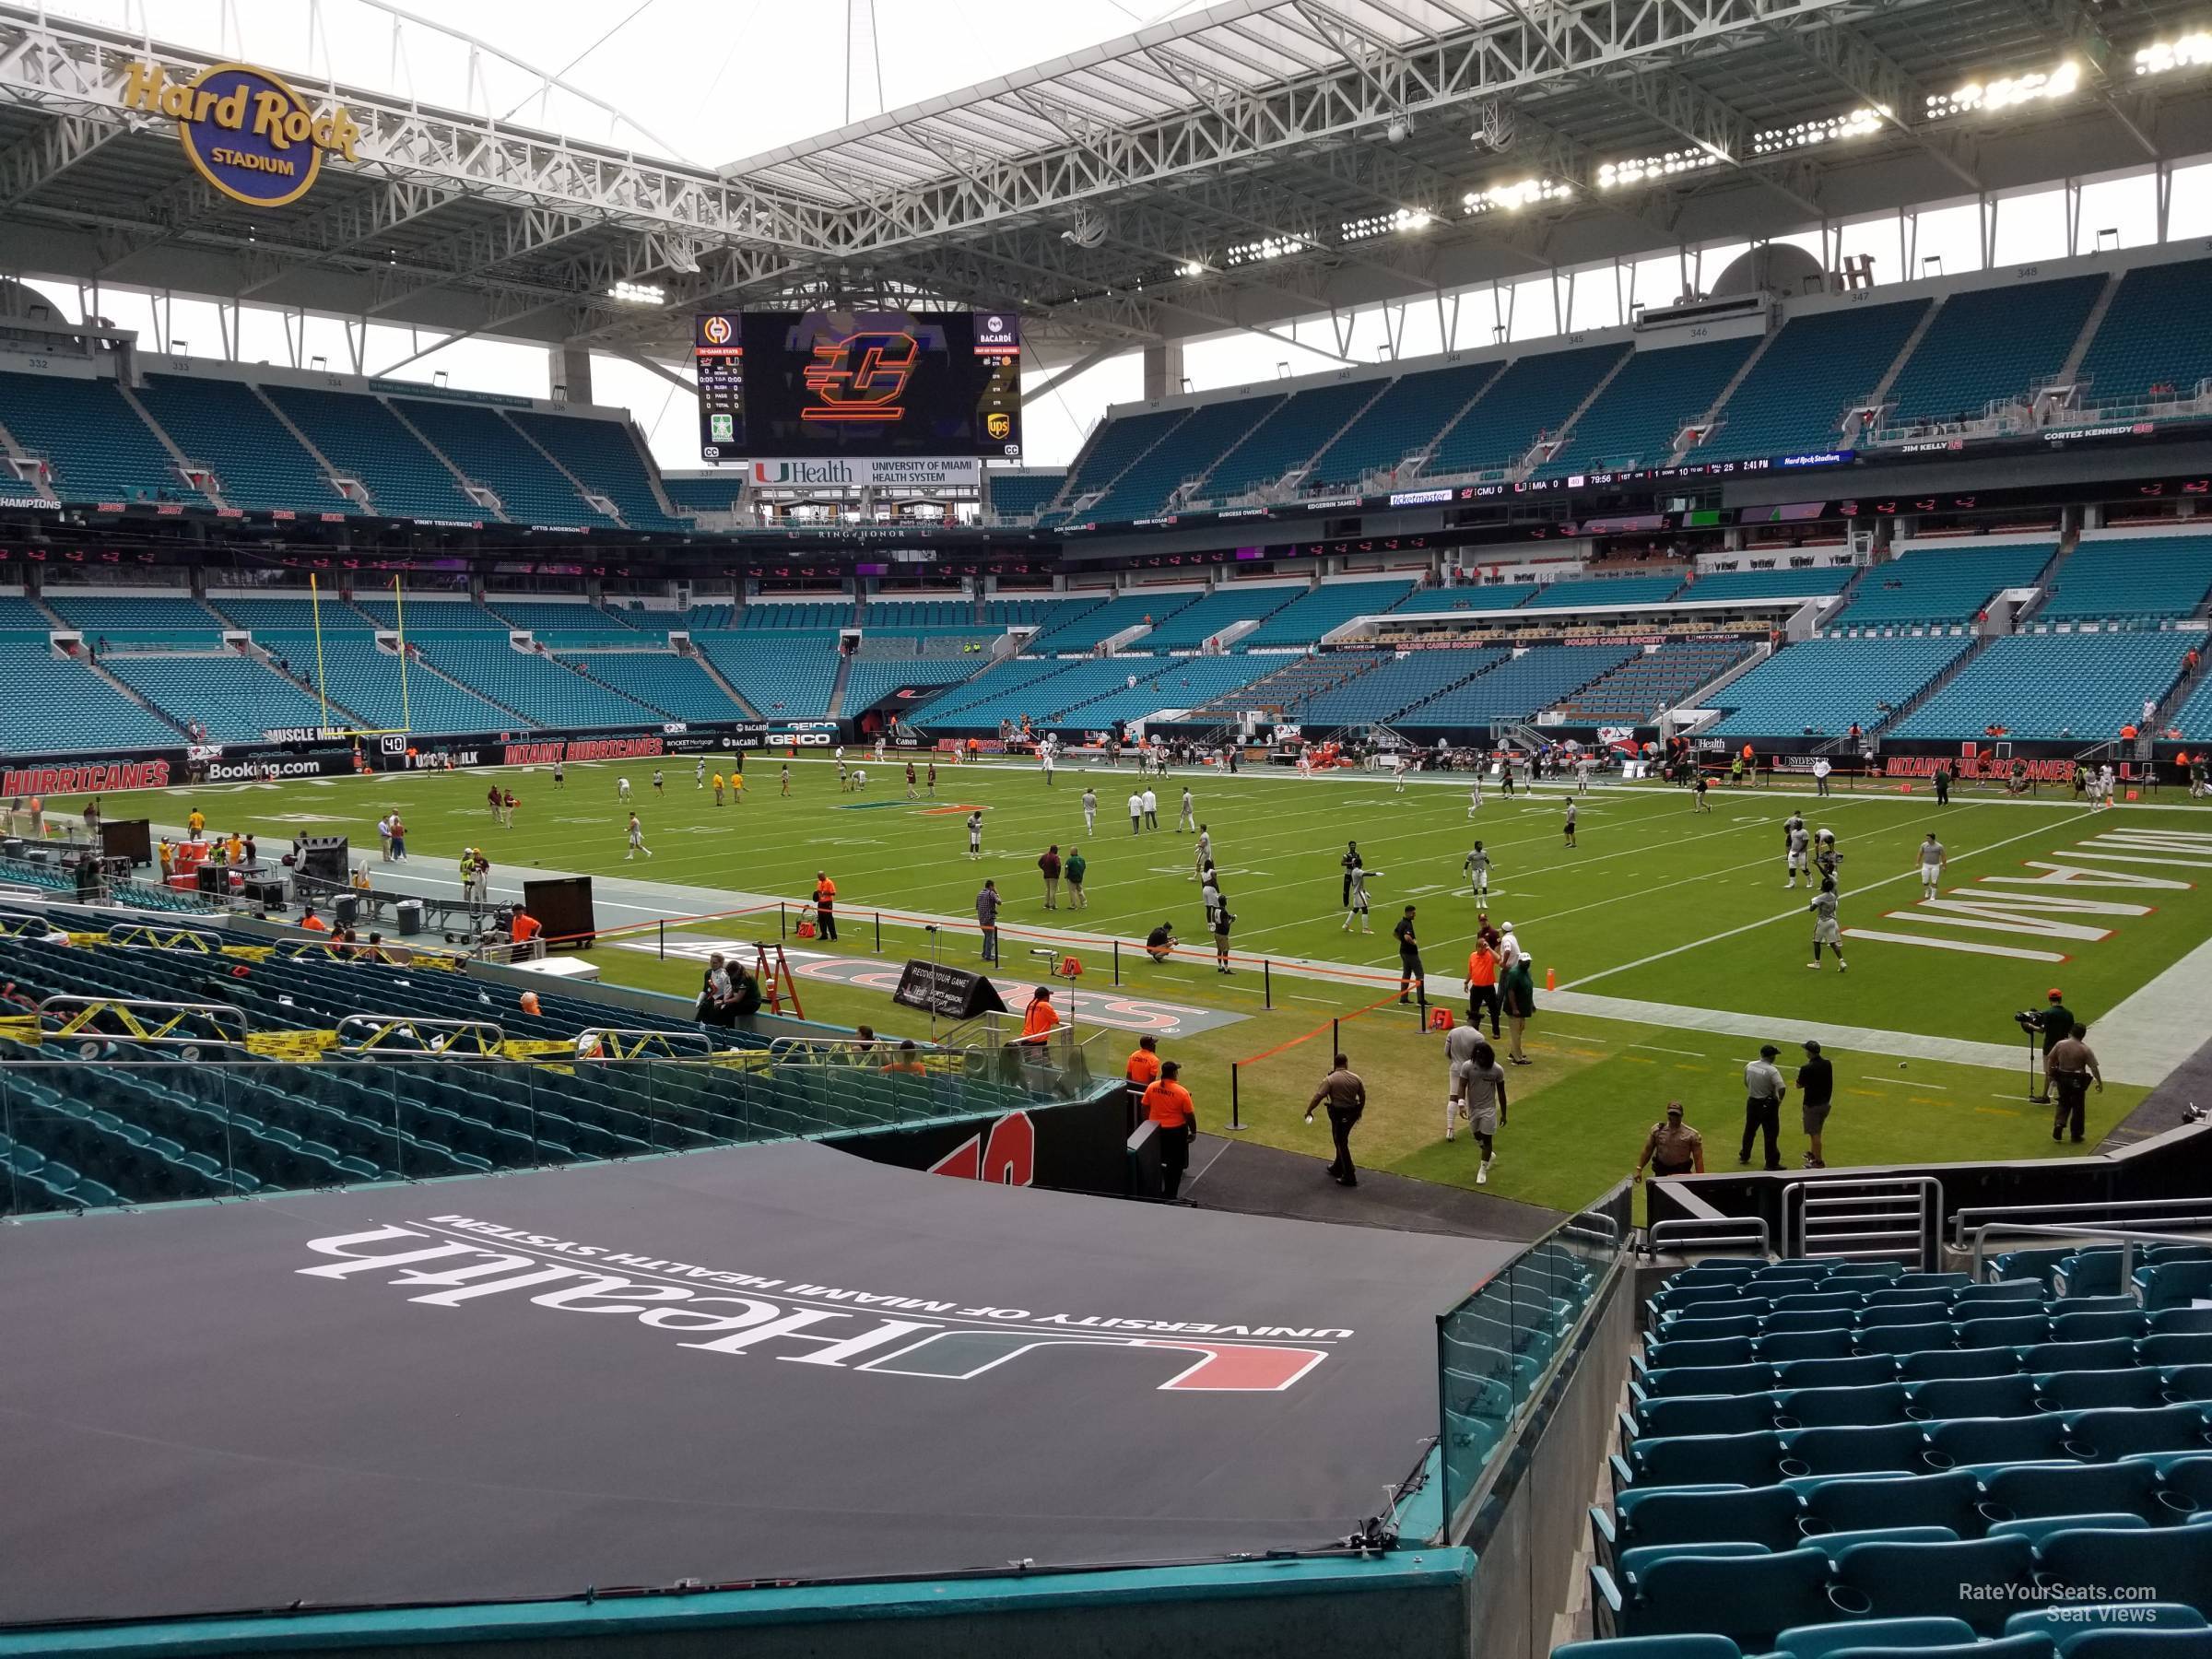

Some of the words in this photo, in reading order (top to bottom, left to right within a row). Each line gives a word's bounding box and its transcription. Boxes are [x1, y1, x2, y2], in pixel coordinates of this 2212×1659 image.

[124, 63, 250, 129] Hard
[253, 90, 359, 162] Rock
[211, 147, 295, 176] STADIUM
[2018, 267, 2037, 277] 348
[1852, 292, 1869, 301] 347
[1691, 329, 1707, 337] 346
[1569, 335, 1583, 344] 345
[29, 359, 48, 369] 332
[1447, 354, 1461, 362] 344
[990, 421, 1008, 435] ups
[2044, 431, 2084, 441] CORTEZ
[2085, 426, 2133, 437] KENNEDY
[705, 448, 718, 456] CC
[1902, 444, 1918, 453] JIM
[1920, 441, 1947, 451] KELLY
[1744, 460, 1757, 471] 2:41
[1759, 459, 1769, 469] PM
[1784, 457, 1799, 465] Hard
[1800, 455, 1814, 465] Rock
[1814, 453, 1840, 463] Stadium
[872, 462, 928, 471] UNIVERSITY
[931, 461, 939, 470] OF
[942, 461, 972, 470] MIAMI
[1678, 467, 1688, 477] 10
[1724, 464, 1734, 472] 25
[873, 473, 907, 482] HEALTH
[909, 473, 946, 482] SYSTEM
[1590, 474, 1611, 485] 79:56
[1532, 481, 1547, 490] MIA
[1553, 479, 1559, 488] 0
[1477, 488, 1495, 496] CMU
[1497, 486, 1502, 494] 0
[0, 497, 62, 510] HAMPIONS
[1393, 492, 1446, 505] ticketmaster
[1308, 501, 1336, 510] EDGERRIN
[434, 520, 473, 528] TESTAVERDE
[267, 728, 317, 743] MUSCLE
[317, 726, 346, 741] MILK
[770, 734, 830, 745] GEICO
[384, 738, 403, 752] 40
[732, 736, 758, 746] BACARDÍ
[896, 737, 917, 746] Canon
[505, 744, 564, 765] MIAMI
[566, 737, 663, 759] HURRICANES
[209, 760, 320, 780] Booking.com
[1886, 756, 1951, 777] MIAMI
[3, 761, 171, 797] HURRICANES
[935, 971, 951, 984] YOUR
[951, 977, 966, 988] GAME
[428, 1215, 610, 1256] SYSTEM
[602, 1253, 786, 1289] HEALTH
[783, 1284, 958, 1313] MIAMI
[955, 1306, 1031, 1320] OF
[1033, 1312, 1355, 1339] UNIVERSITY
